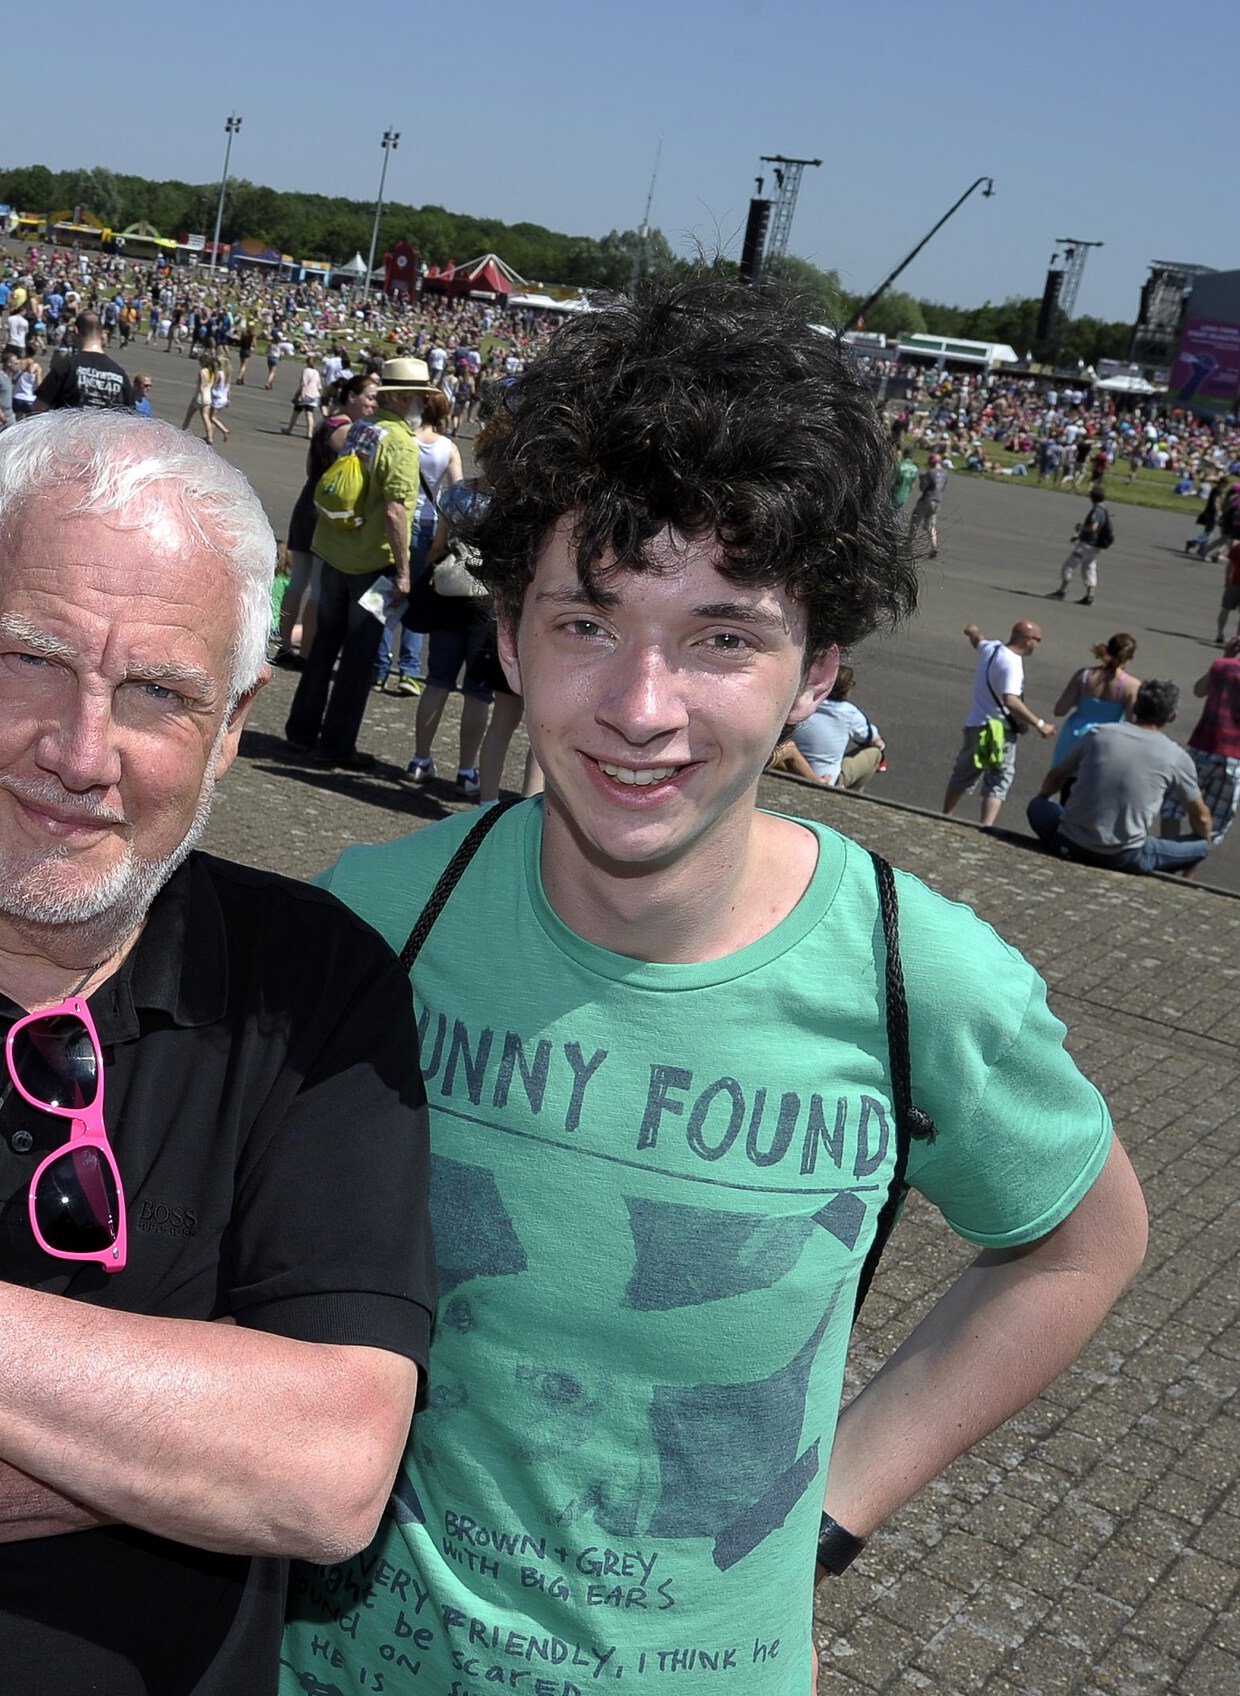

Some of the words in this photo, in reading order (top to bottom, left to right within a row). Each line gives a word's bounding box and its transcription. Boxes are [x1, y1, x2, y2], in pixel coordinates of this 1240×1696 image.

[636, 1063, 890, 1181] FOUND
[137, 1218, 165, 1233] HUGO
[140, 1199, 198, 1228] BOSS
[442, 1537, 500, 1580] WITH
[520, 1566, 570, 1602] BIG
[586, 1577, 675, 1610] EARS
[444, 1509, 547, 1560] BROWN
[575, 1547, 659, 1587] GREY
[360, 1552, 431, 1615] VERY
[656, 1648, 737, 1673] THINK
[752, 1637, 781, 1664] he
[394, 1610, 434, 1651] be
[311, 1633, 346, 1669] HE
[359, 1666, 385, 1693] IS
